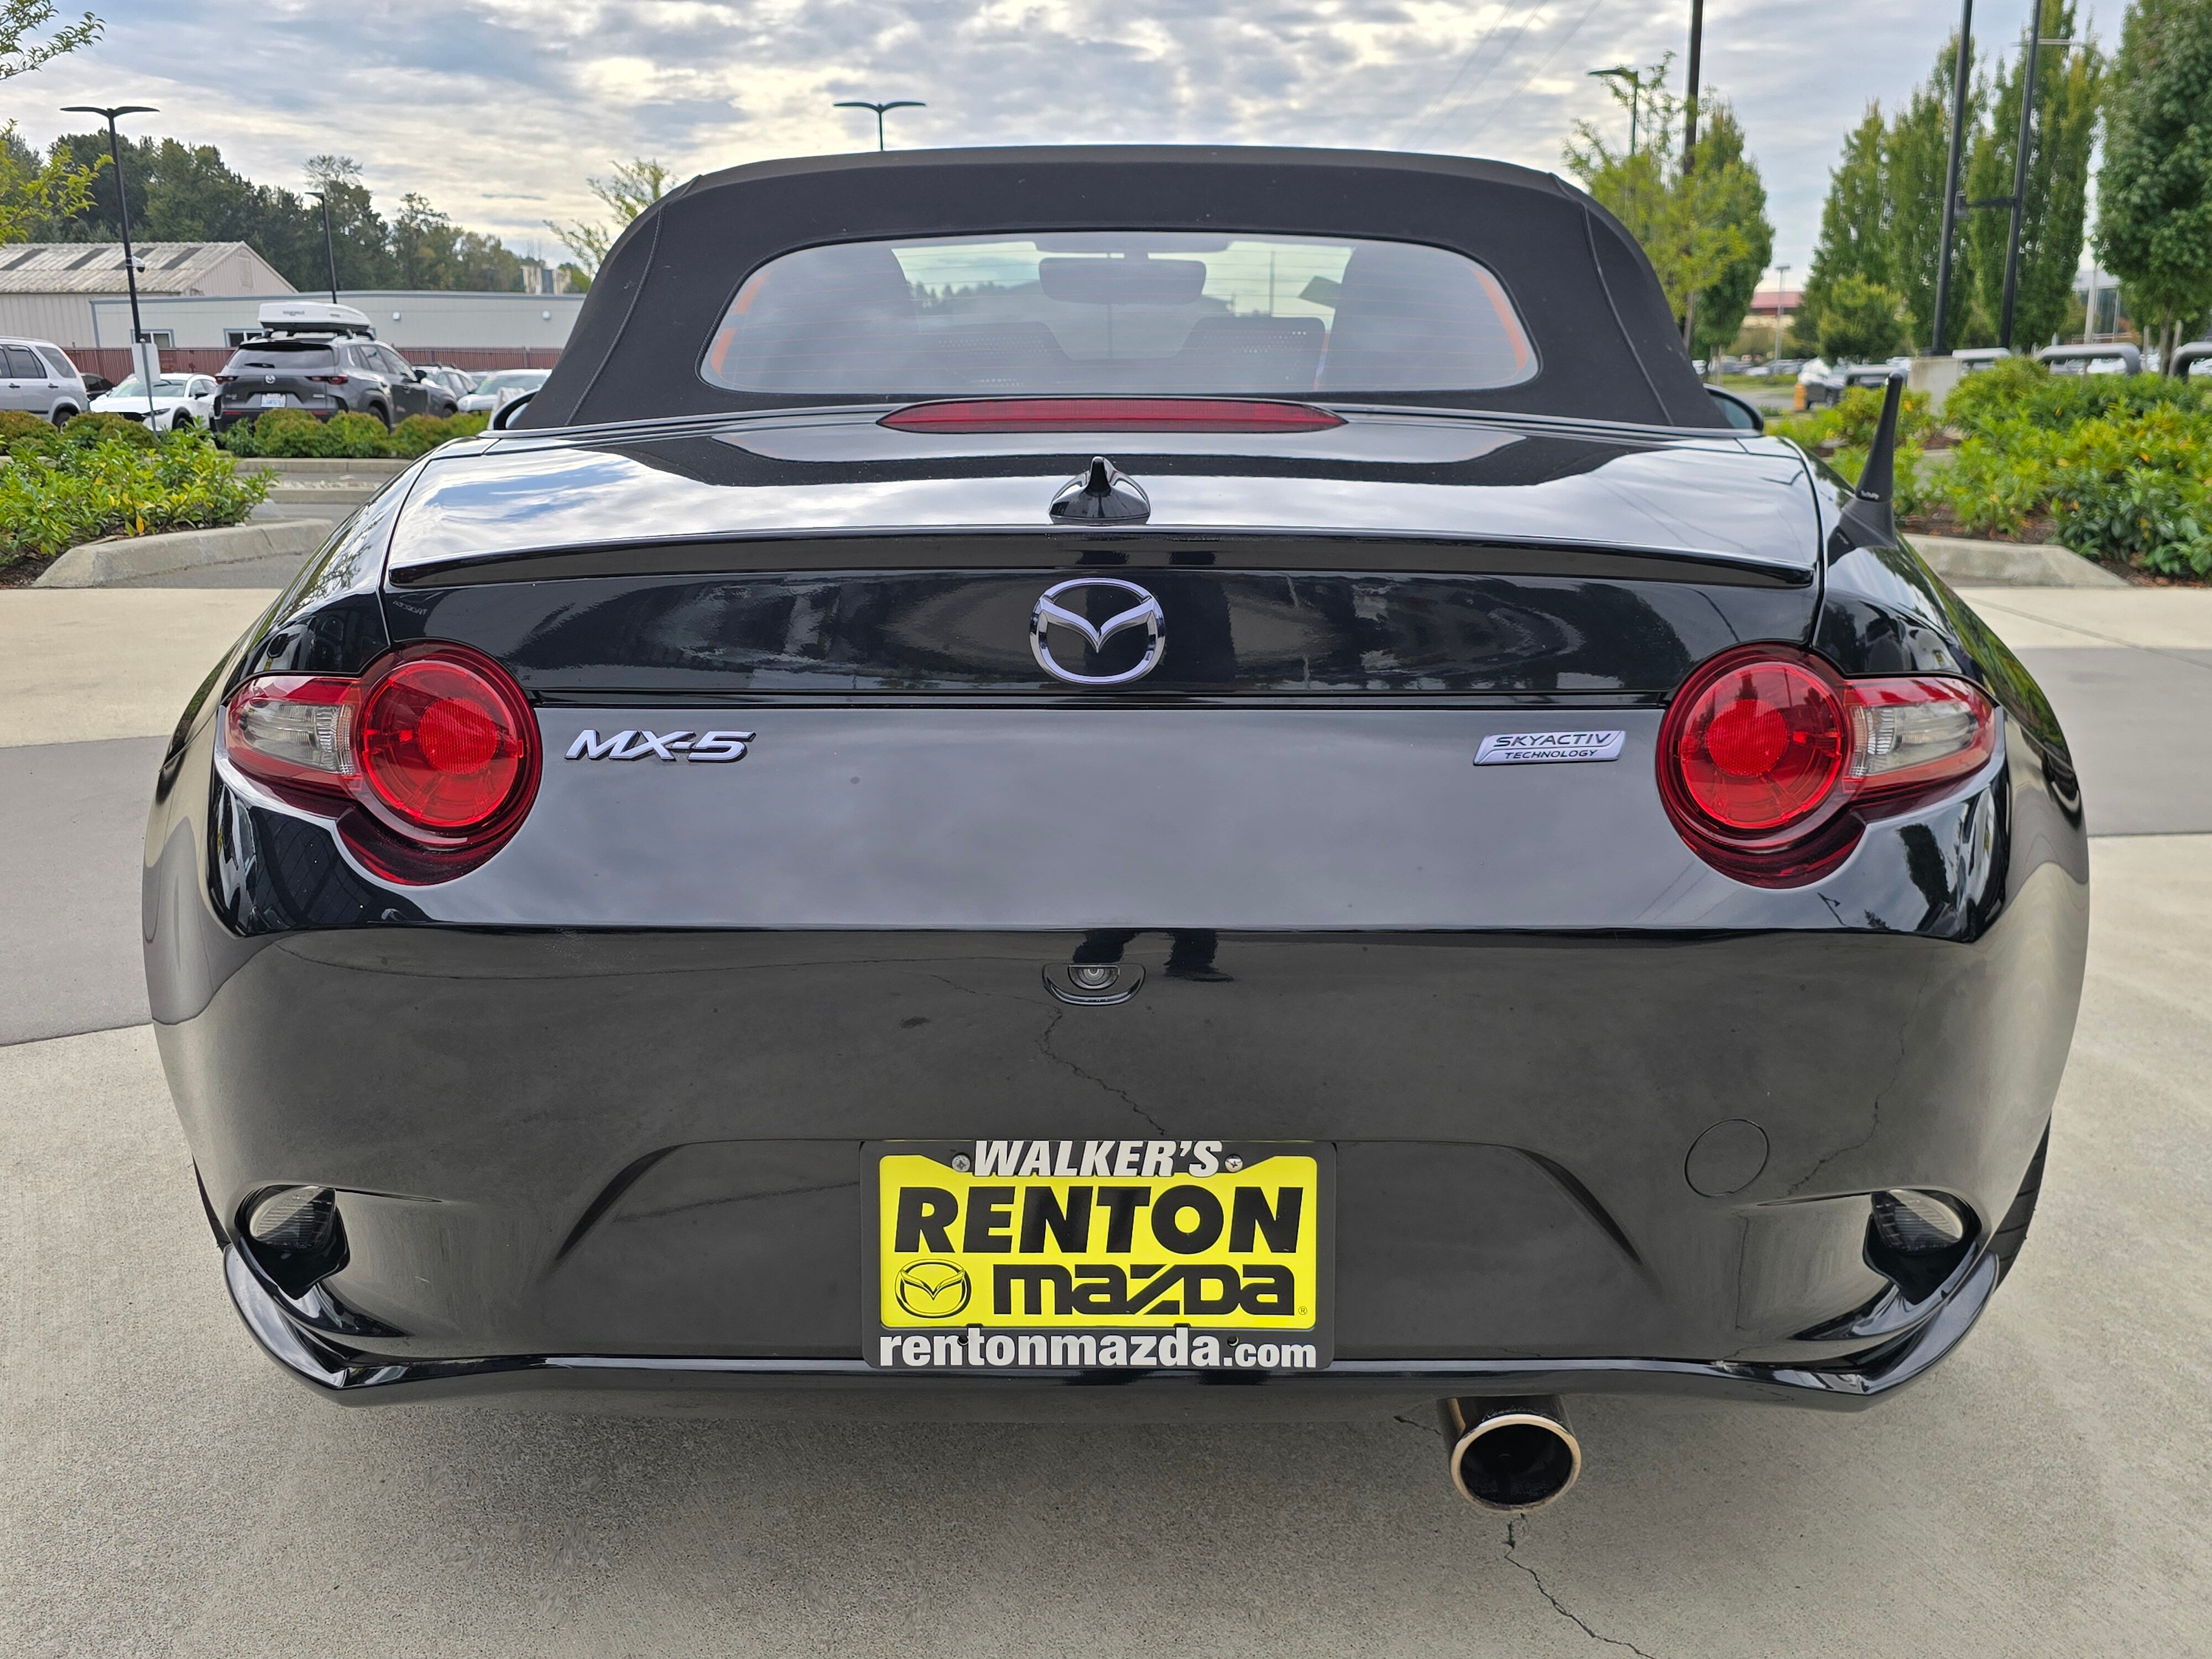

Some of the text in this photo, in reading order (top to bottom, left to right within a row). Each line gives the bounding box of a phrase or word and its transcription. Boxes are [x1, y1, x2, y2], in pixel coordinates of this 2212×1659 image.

[564, 729, 757, 763] MX-5
[1494, 733, 1611, 747] SKYACTIV
[1504, 750, 1598, 759] TECHNOLOGY
[973, 1140, 1222, 1178] WALKER'S
[894, 1185, 1303, 1254] RENTON
[879, 1327, 1316, 1367] rentonmazda.com
